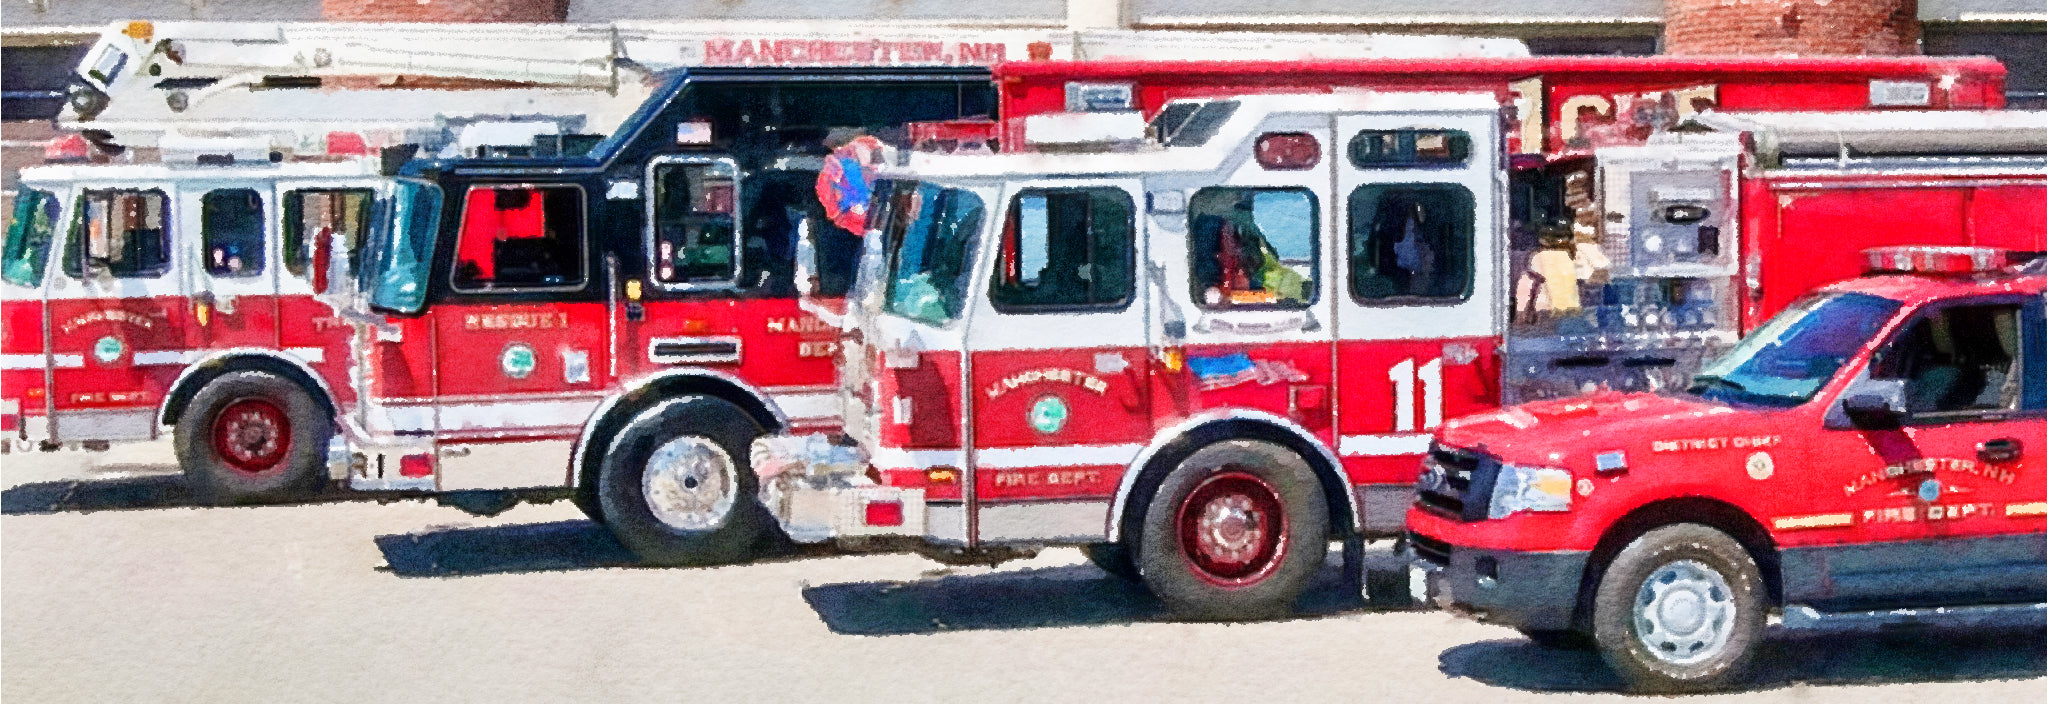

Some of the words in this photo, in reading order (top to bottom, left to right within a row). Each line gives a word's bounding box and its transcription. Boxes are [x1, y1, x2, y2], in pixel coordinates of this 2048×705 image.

[464, 312, 553, 330] RESCUE
[984, 368, 1108, 400] MANCHESTER
[1388, 357, 1442, 432] 11
[1652, 437, 1728, 452] DISTRICT
[994, 471, 1041, 486] FIRE
[1862, 506, 1916, 524] FIRE
